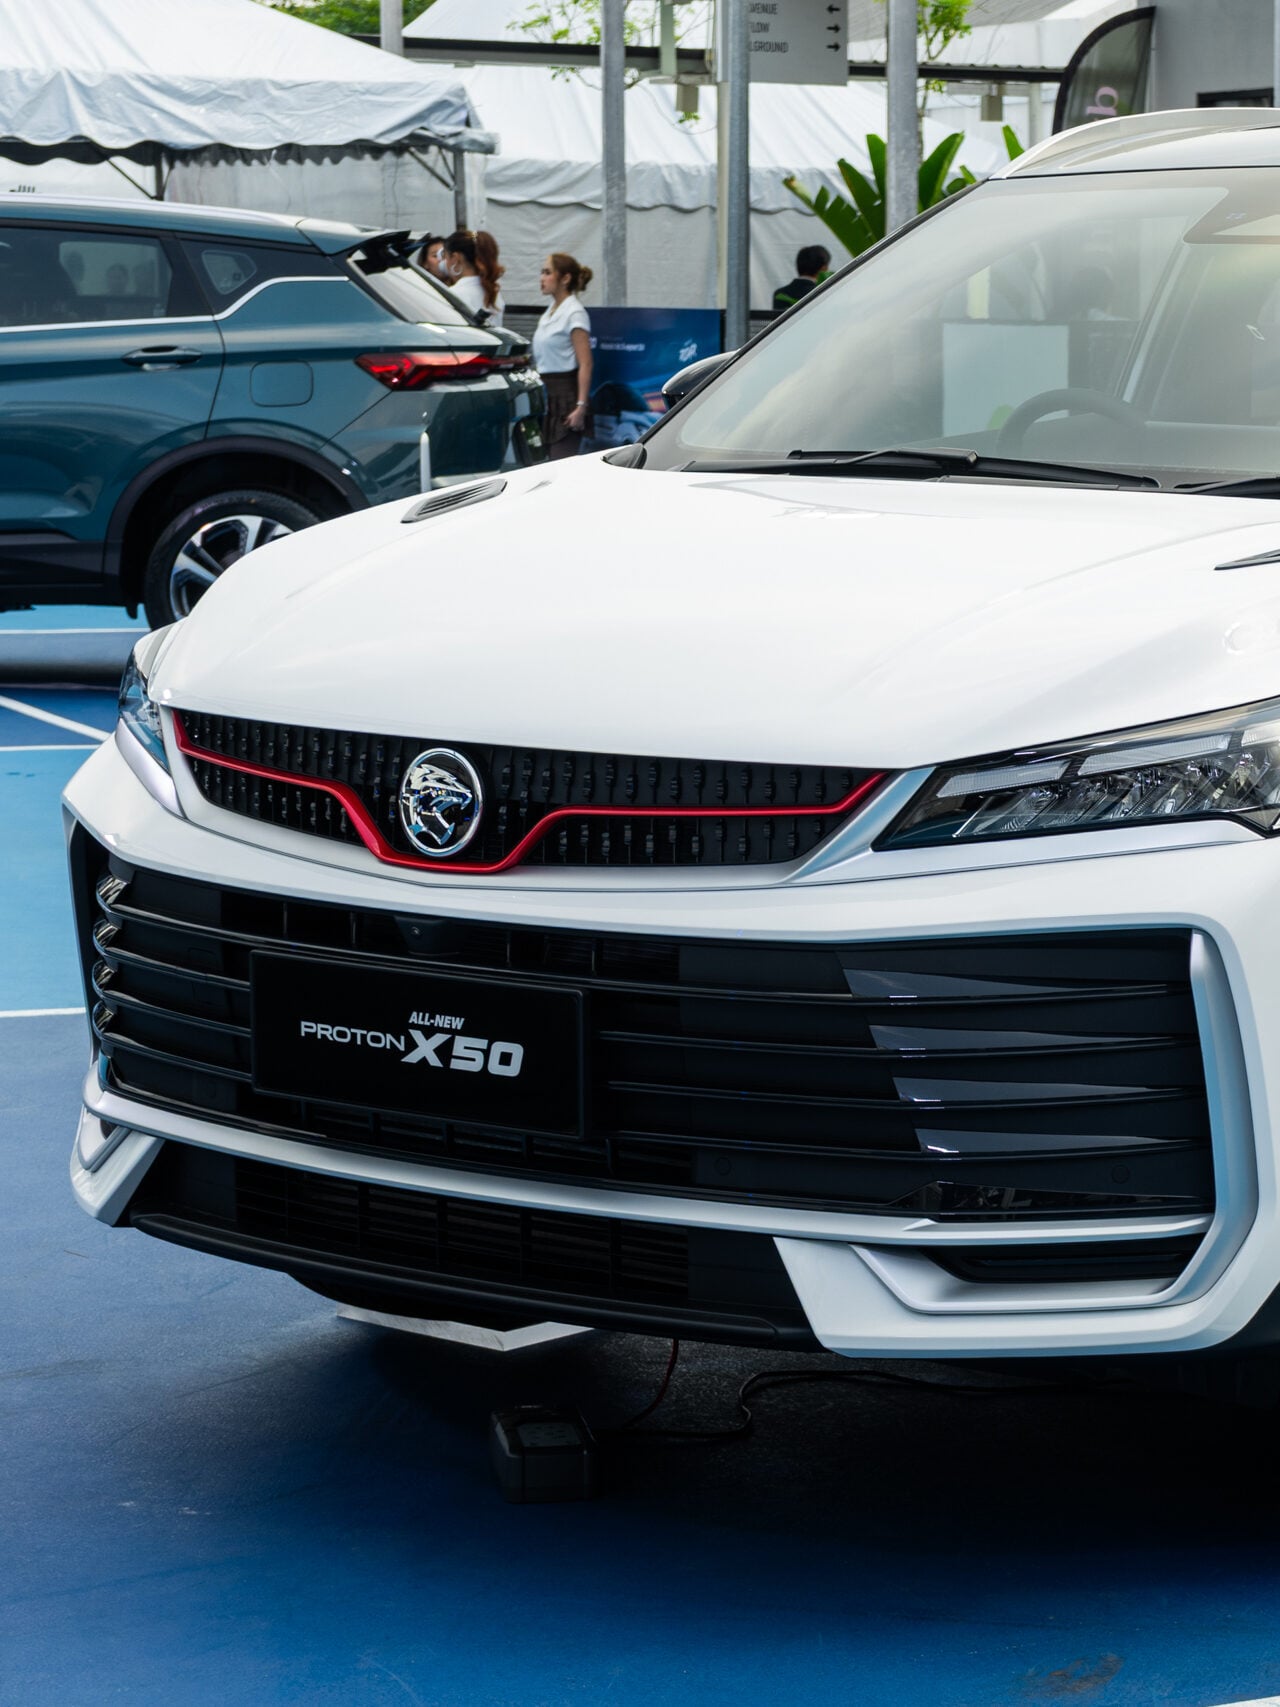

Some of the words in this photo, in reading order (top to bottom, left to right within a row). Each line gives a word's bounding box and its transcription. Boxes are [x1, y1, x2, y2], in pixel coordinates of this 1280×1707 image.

[408, 1011, 465, 1030] ALL-NEW
[300, 1020, 406, 1051] PROTON
[400, 1028, 525, 1078] X50
